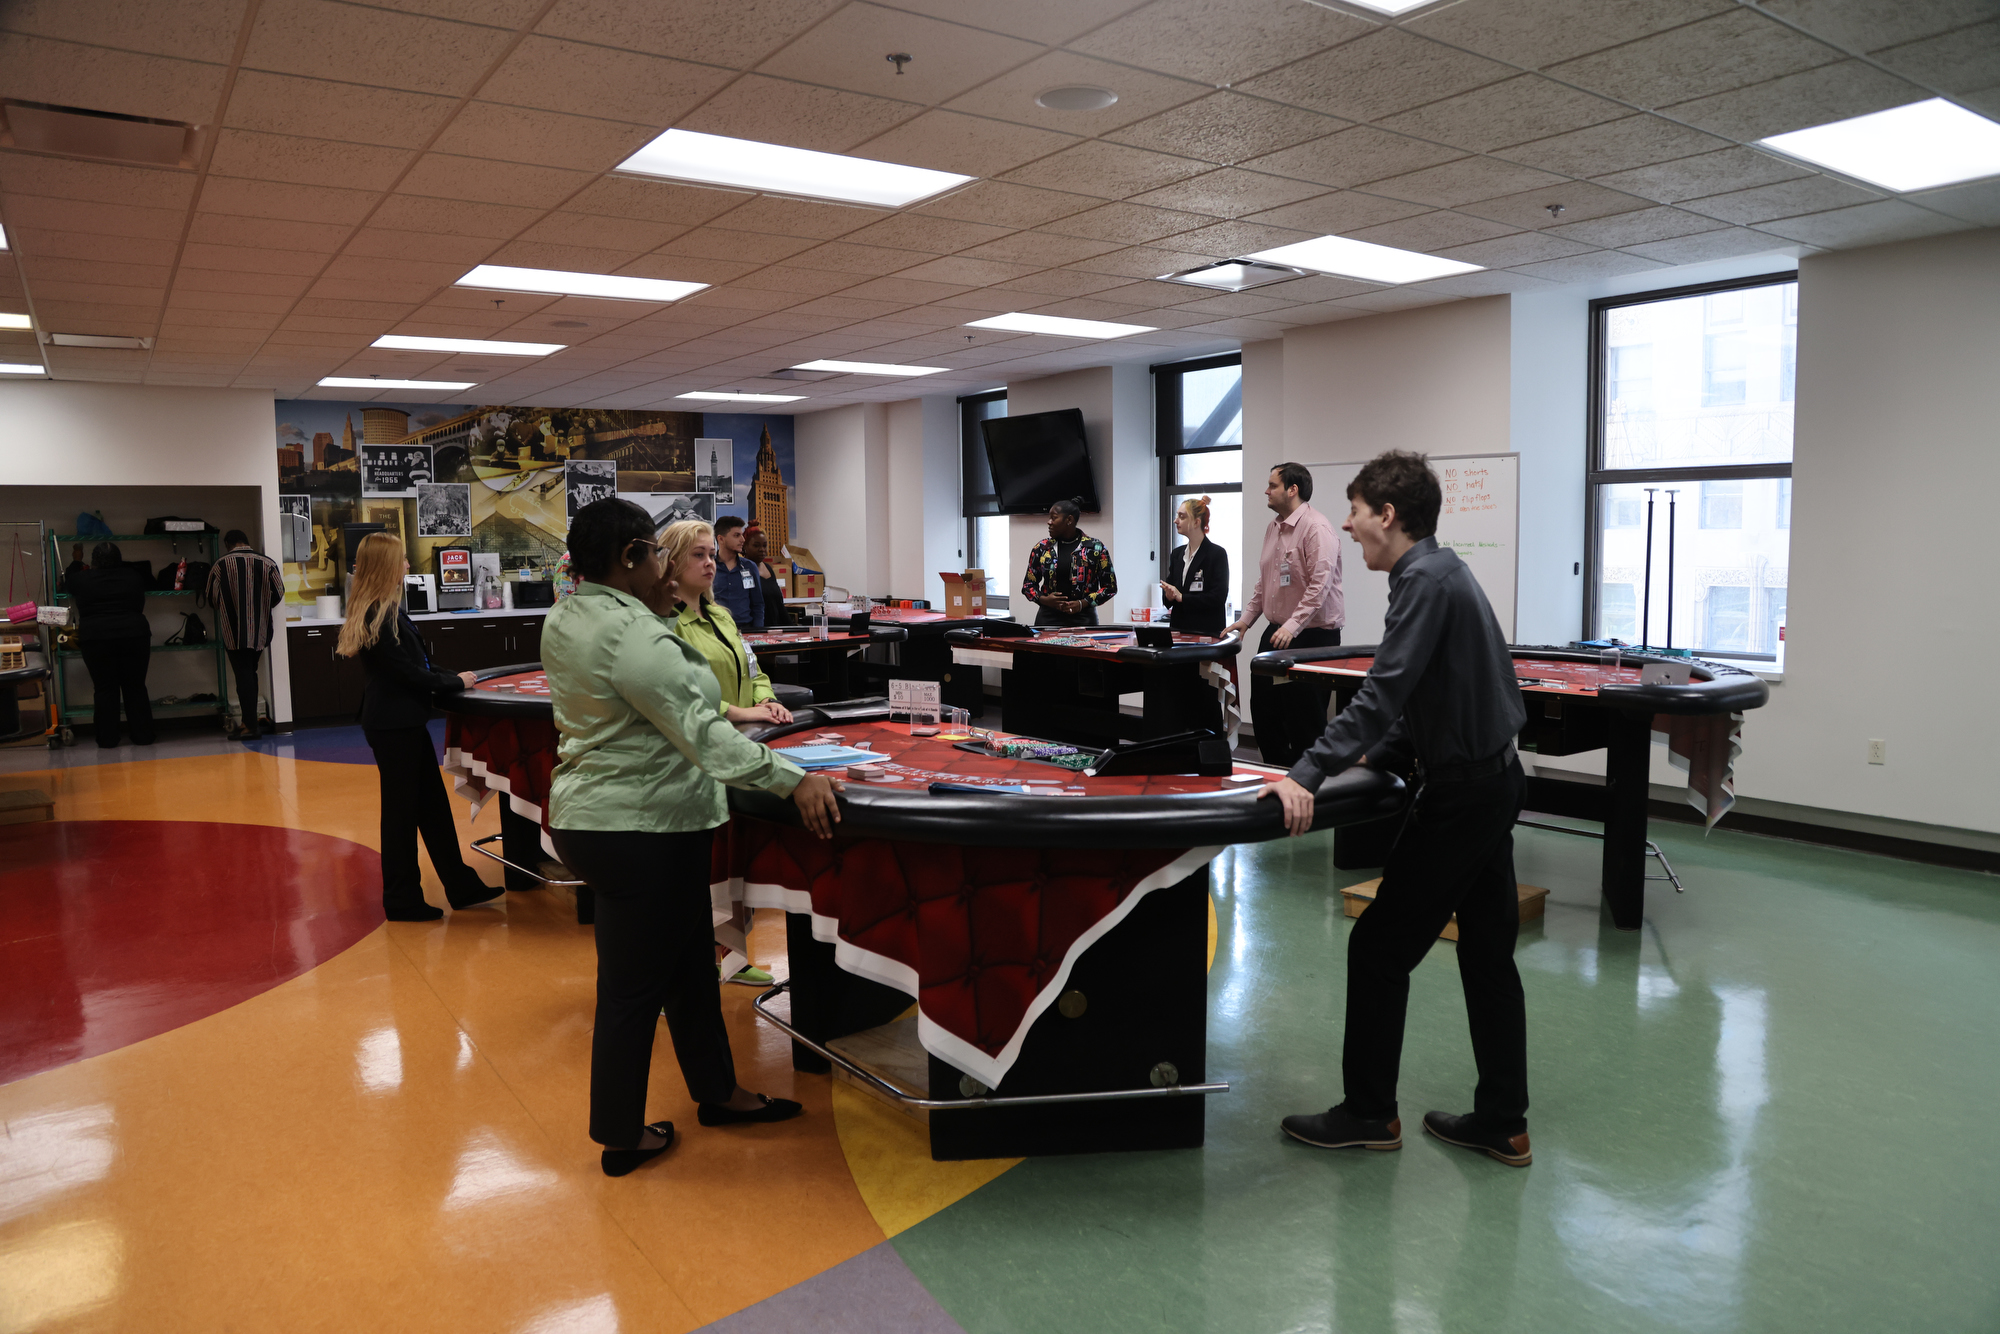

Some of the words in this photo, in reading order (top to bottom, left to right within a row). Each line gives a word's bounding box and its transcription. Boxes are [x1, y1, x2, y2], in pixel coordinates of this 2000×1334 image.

[1445, 468, 1458, 479] NO
[1464, 468, 1489, 477] shorts
[382, 476, 399, 484] 1955
[1446, 482, 1459, 492] NO
[1446, 496, 1456, 504] NO
